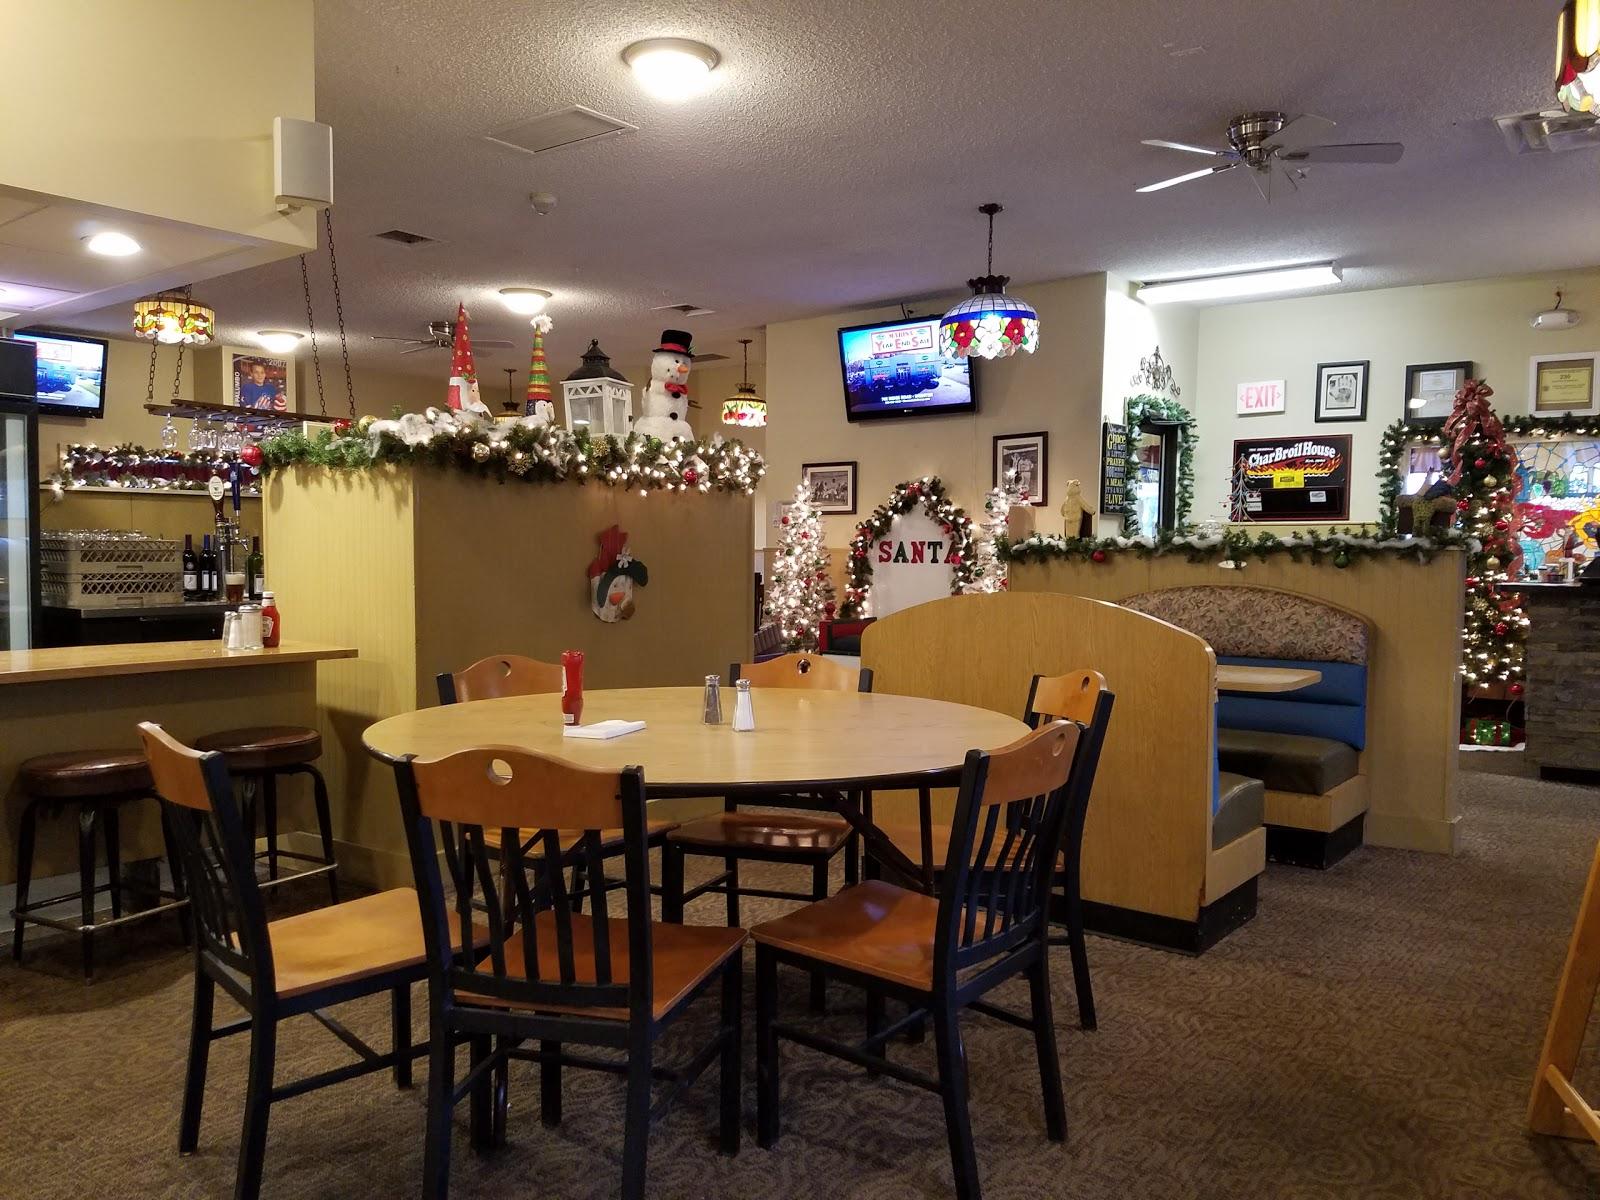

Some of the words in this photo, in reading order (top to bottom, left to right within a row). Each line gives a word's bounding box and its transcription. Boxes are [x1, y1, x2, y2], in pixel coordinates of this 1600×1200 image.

[1245, 385, 1278, 408] EXIT
[1302, 441, 1336, 458] House
[1106, 457, 1125, 466] PRAYER
[1108, 493, 1123, 505] LIVE
